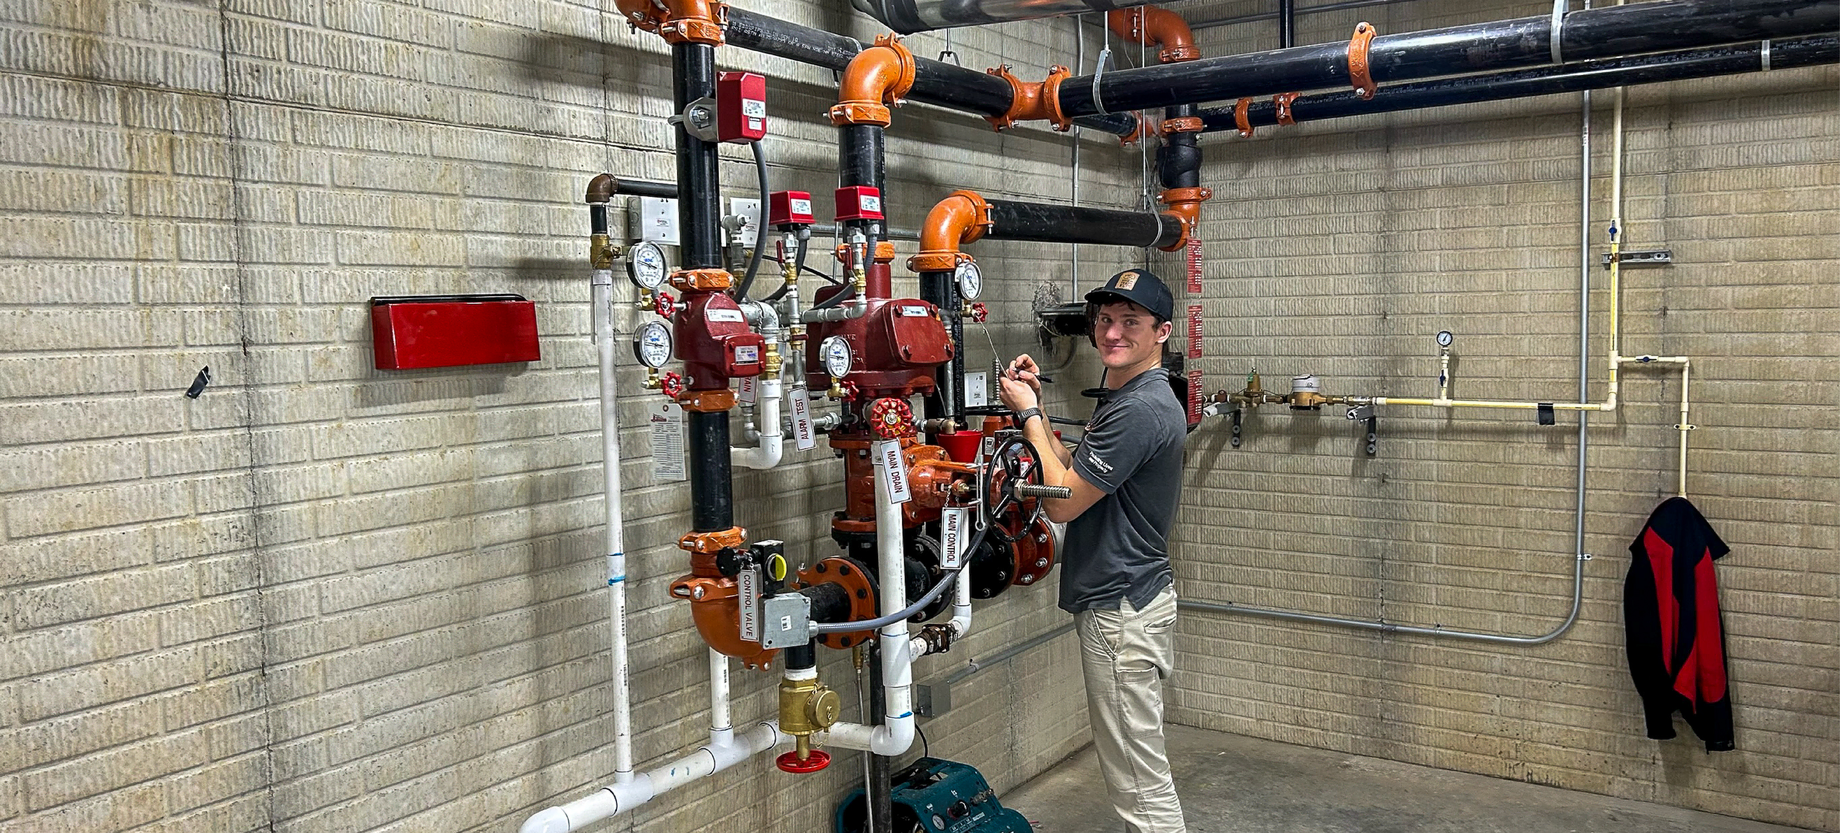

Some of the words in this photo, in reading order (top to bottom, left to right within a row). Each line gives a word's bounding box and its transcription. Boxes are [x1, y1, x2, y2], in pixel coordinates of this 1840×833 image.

[743, 376, 752, 393] RAIN
[794, 398, 804, 415] TEST
[798, 418, 809, 440] ALARM
[887, 450, 898, 469] MAIN
[891, 471, 904, 494] DRAIN
[947, 513, 957, 532] MAIN
[946, 532, 956, 563] CONTROL
[743, 574, 752, 610] CONTROL
[745, 612, 753, 637] VALVE
